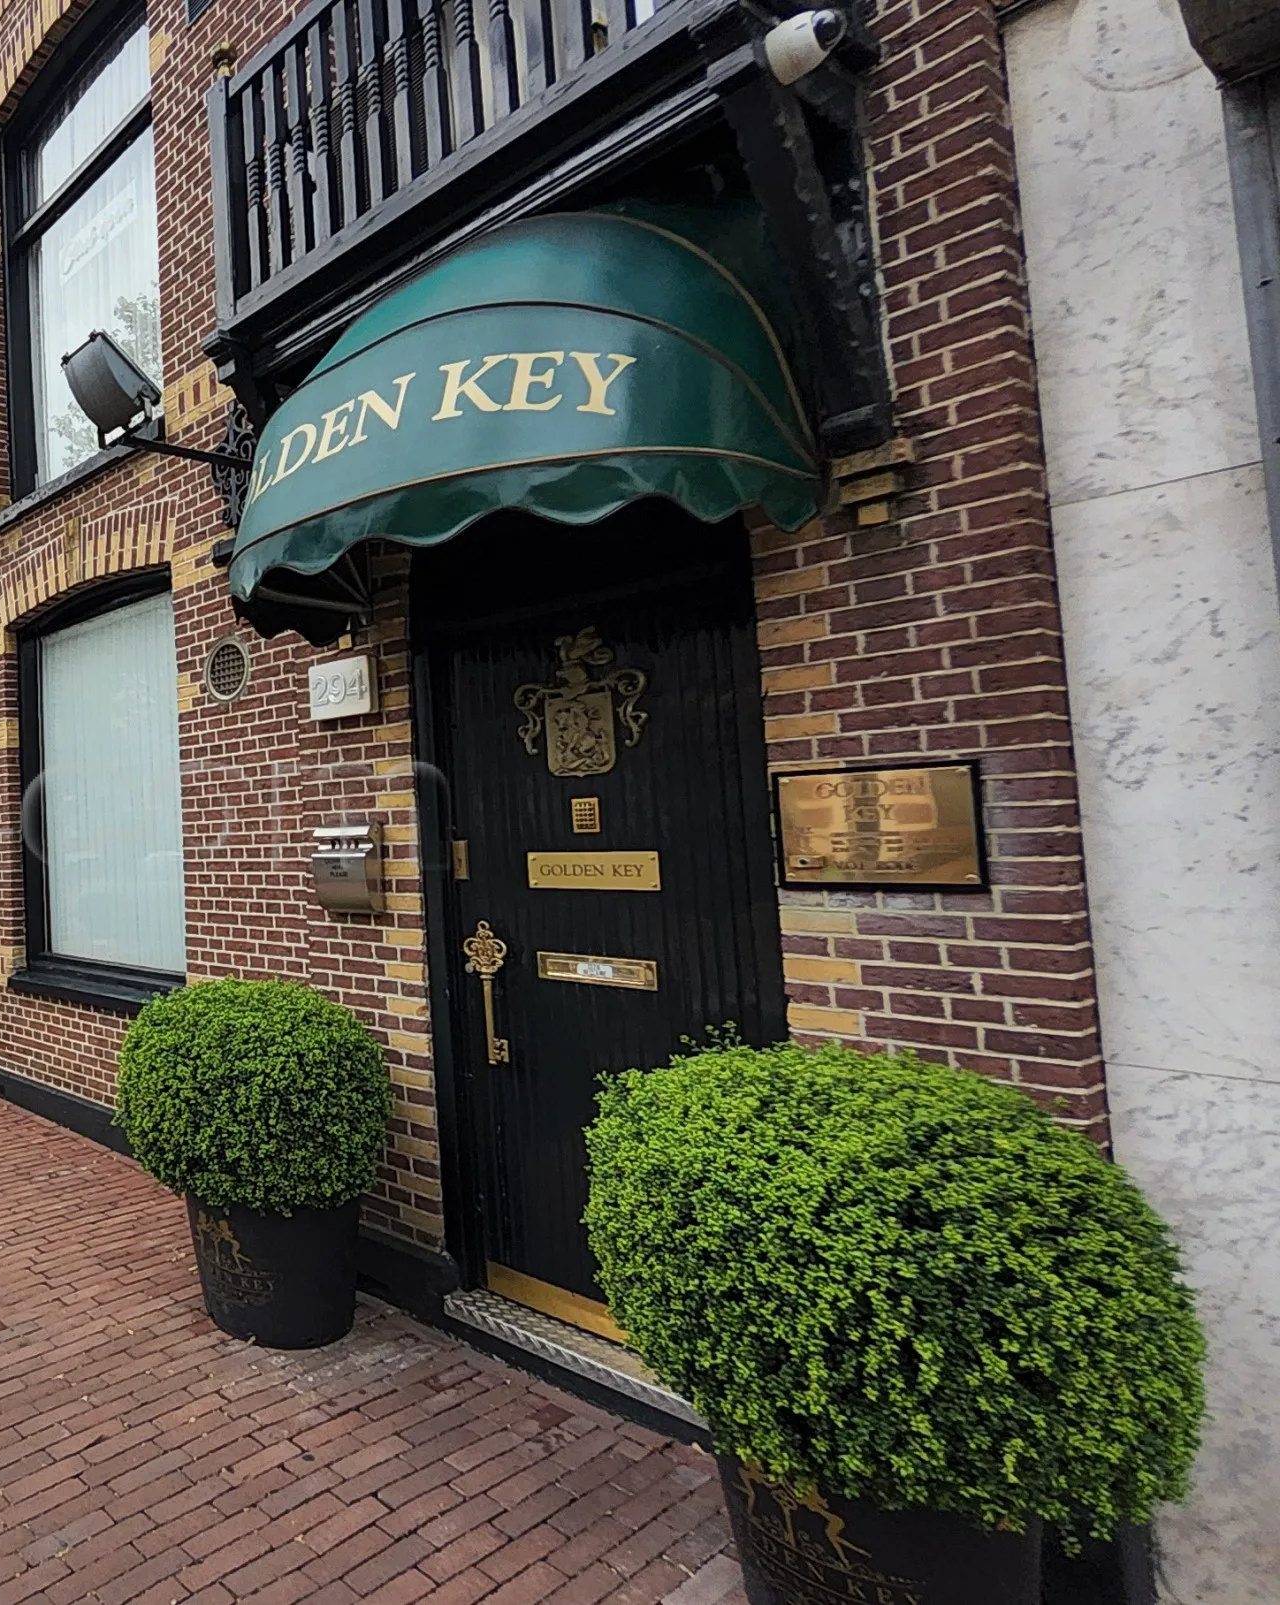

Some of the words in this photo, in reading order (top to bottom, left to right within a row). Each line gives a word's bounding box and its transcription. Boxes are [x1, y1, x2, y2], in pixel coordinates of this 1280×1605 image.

[431, 350, 637, 421] KEY
[312, 667, 368, 707] 294
[815, 776, 926, 799] GOLDEN
[844, 803, 895, 823] KEY
[539, 864, 605, 877] GOLDEN
[612, 864, 644, 877] KEY
